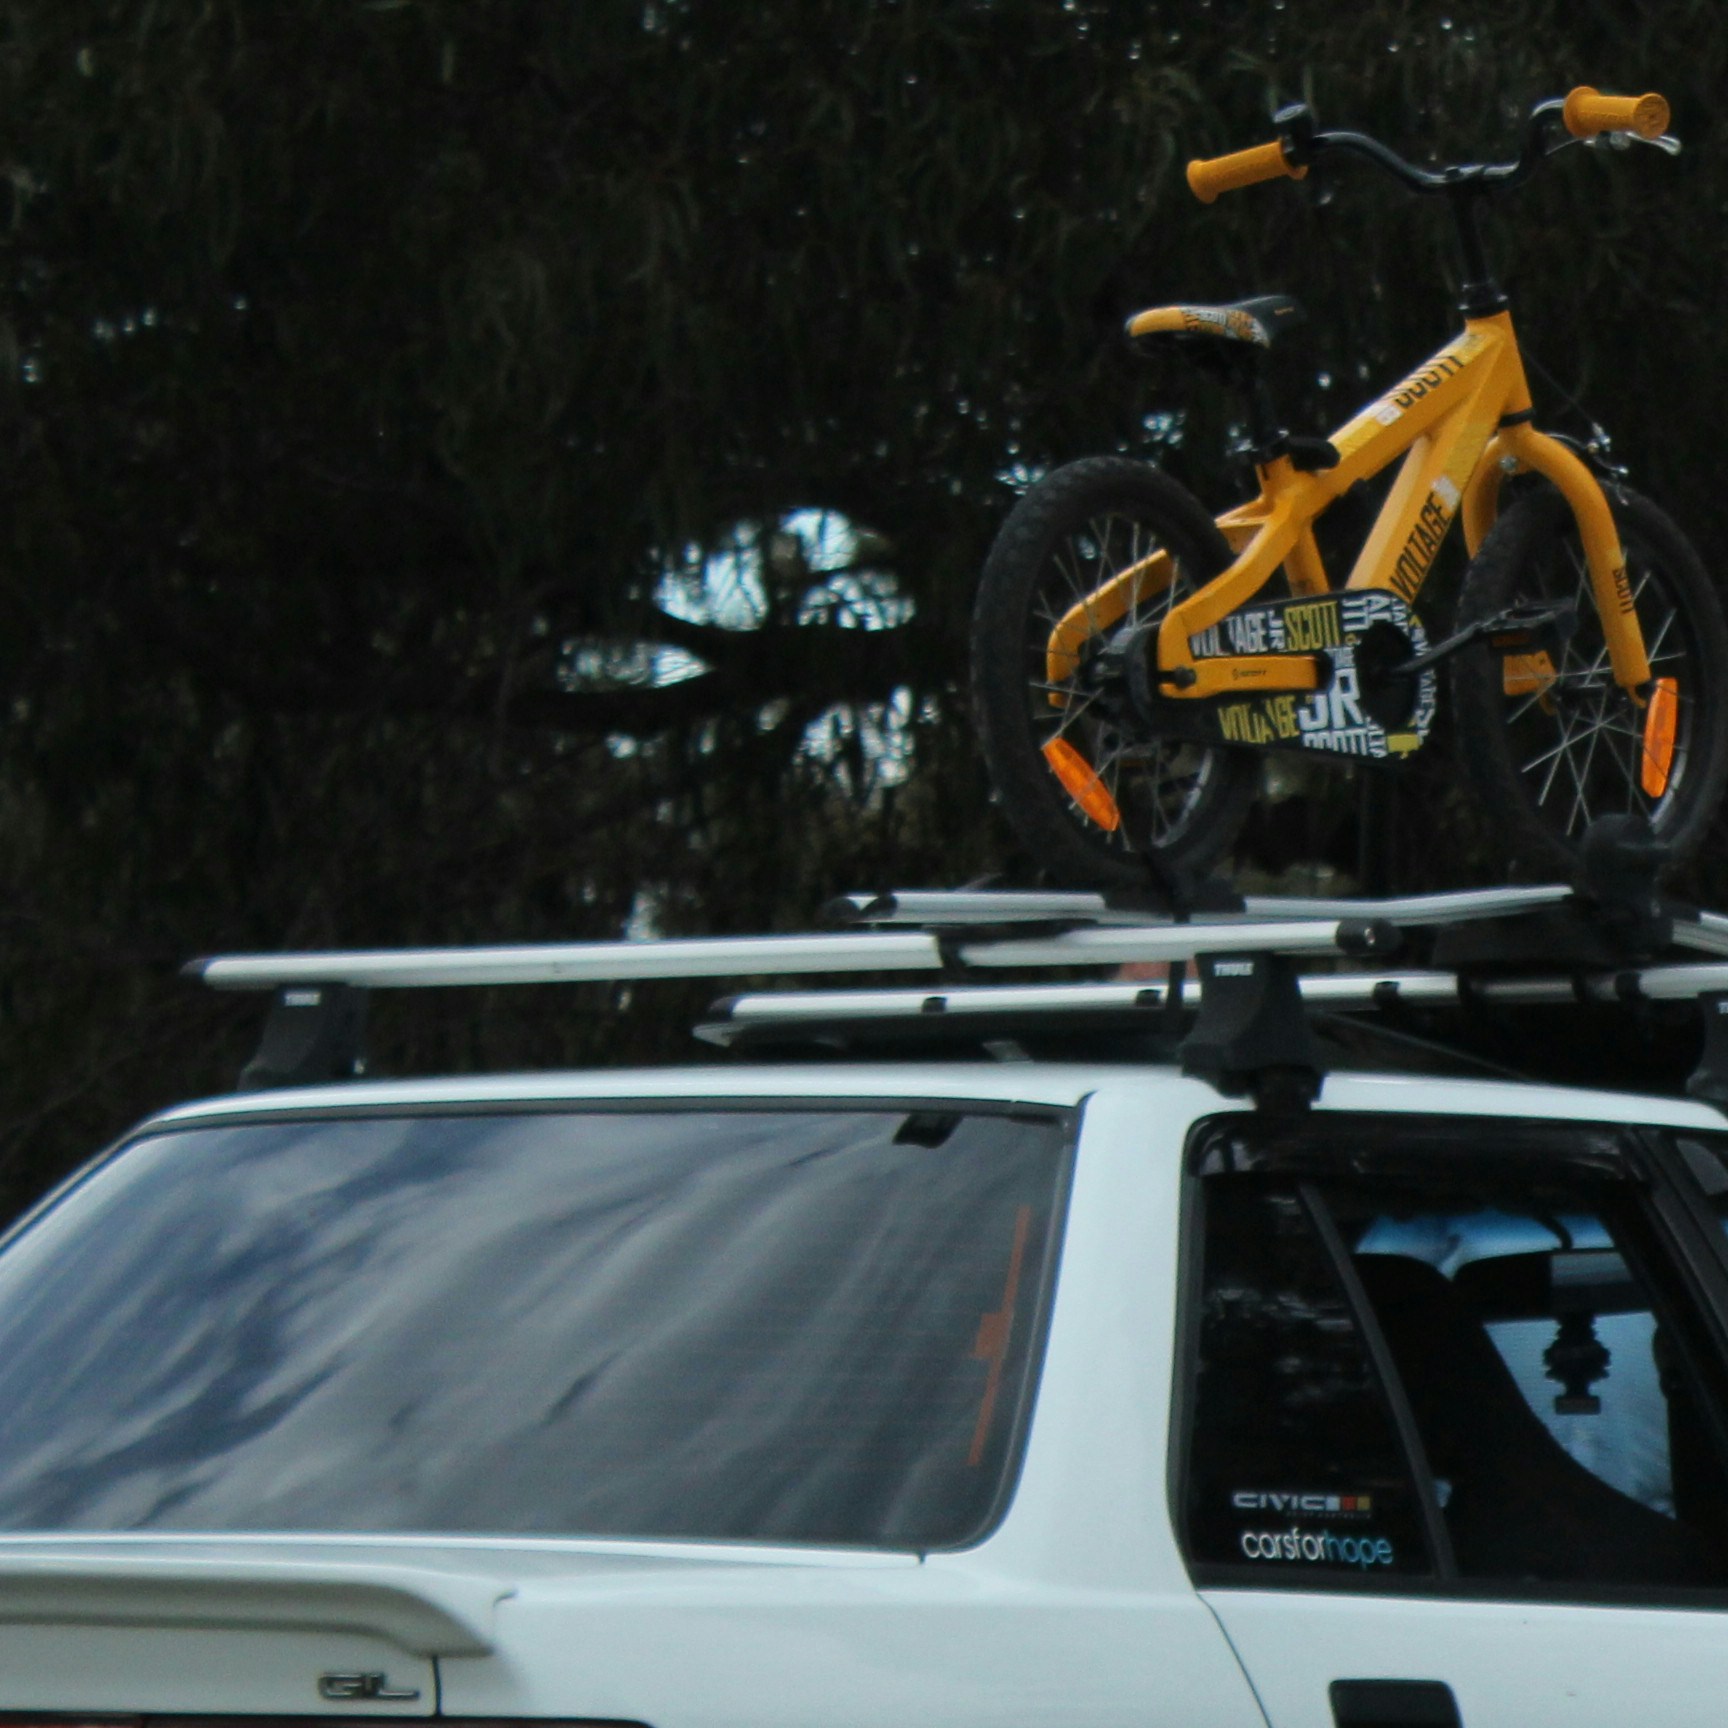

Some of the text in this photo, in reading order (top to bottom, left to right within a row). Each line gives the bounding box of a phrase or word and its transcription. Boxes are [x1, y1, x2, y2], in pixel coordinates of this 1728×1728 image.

[1388, 490, 1453, 603] VOLTAGE
[1284, 601, 1341, 650] SCOTT
[1232, 1491, 1325, 1511] CIVIC
